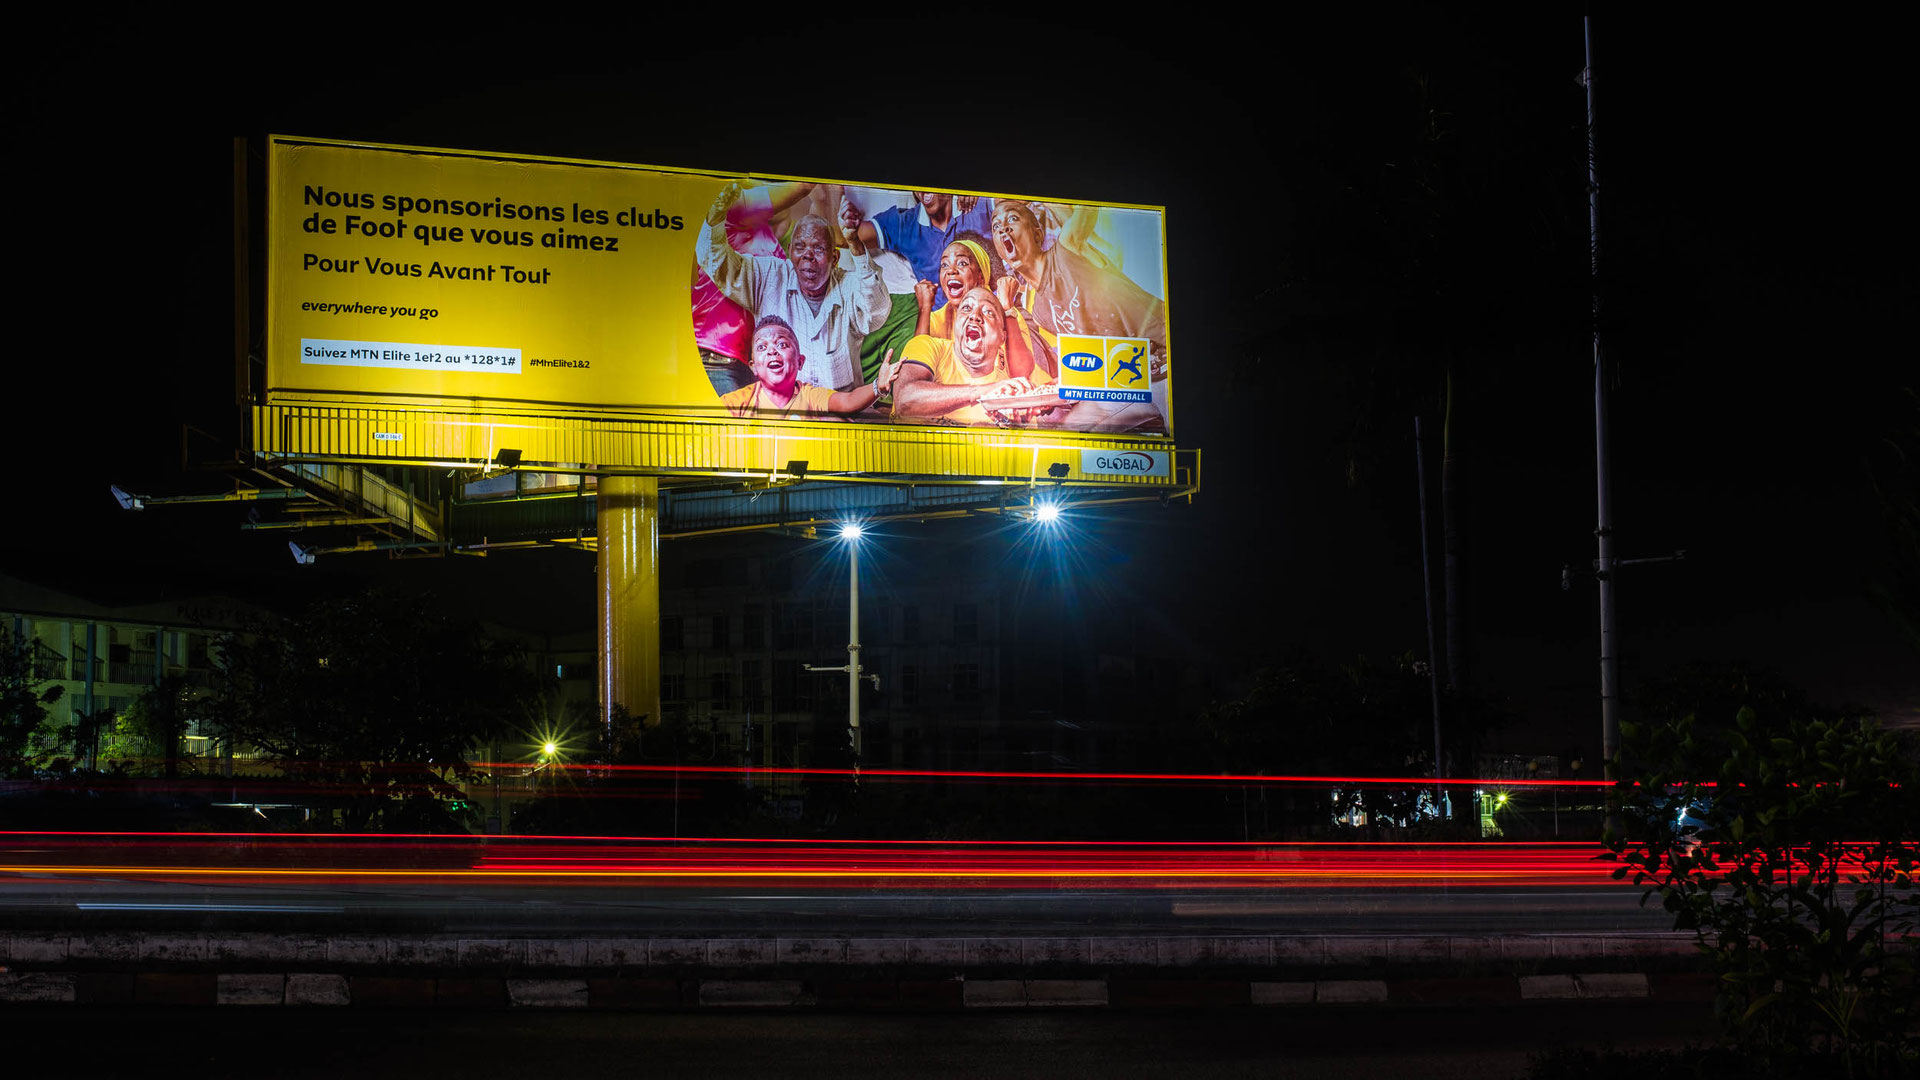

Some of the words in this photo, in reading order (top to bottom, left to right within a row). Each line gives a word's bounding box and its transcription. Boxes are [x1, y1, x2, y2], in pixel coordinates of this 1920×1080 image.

[304, 185, 375, 209] Nous
[382, 194, 565, 222] sponsorisons
[573, 203, 609, 225] les
[616, 207, 684, 231] clubs
[303, 212, 337, 234] de
[345, 215, 407, 238] Foot
[414, 224, 464, 246] que
[470, 228, 534, 247] vous
[541, 228, 619, 252] aimez
[303, 253, 360, 273] Pour
[365, 257, 422, 277] Vous
[428, 261, 496, 281] Avant
[500, 265, 551, 284] Tout
[301, 301, 388, 315] everywhere
[389, 305, 417, 318] you
[419, 307, 439, 320] go
[304, 346, 347, 359] Suivez
[350, 349, 379, 360] MTN
[382, 350, 411, 362] Elite
[414, 351, 442, 363] 1et2
[445, 355, 461, 364] au
[1069, 356, 1096, 368] MTN
[1064, 390, 1082, 398] MTN
[1084, 391, 1104, 399] ELITE
[1096, 457, 1146, 471] GLOBAL
